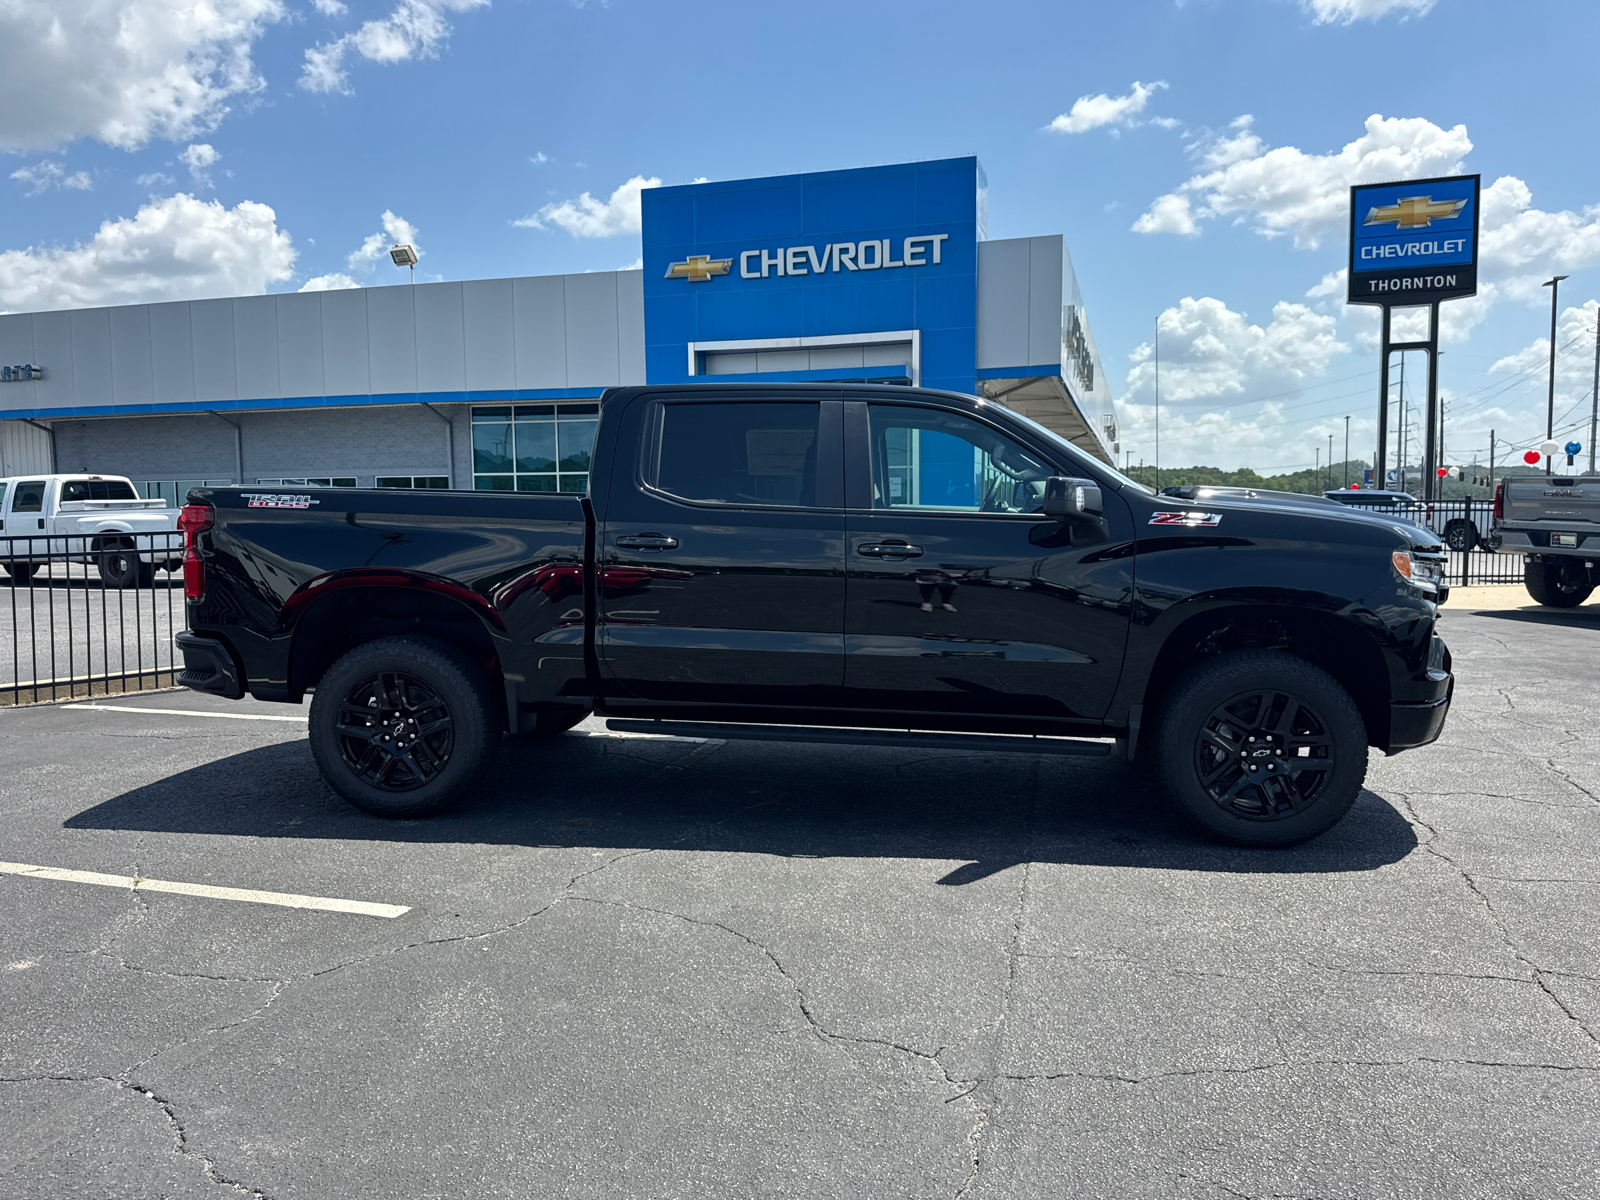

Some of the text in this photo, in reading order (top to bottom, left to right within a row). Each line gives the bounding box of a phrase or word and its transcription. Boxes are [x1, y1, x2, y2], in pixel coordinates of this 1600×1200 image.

[740, 233, 949, 279] CHEVROLET
[1361, 239, 1466, 260] CHEVROLET
[1369, 275, 1456, 292] THORNTON
[0, 364, 33, 381] RTS
[1543, 489, 1583, 498] GMC
[1147, 511, 1224, 527] Z71
